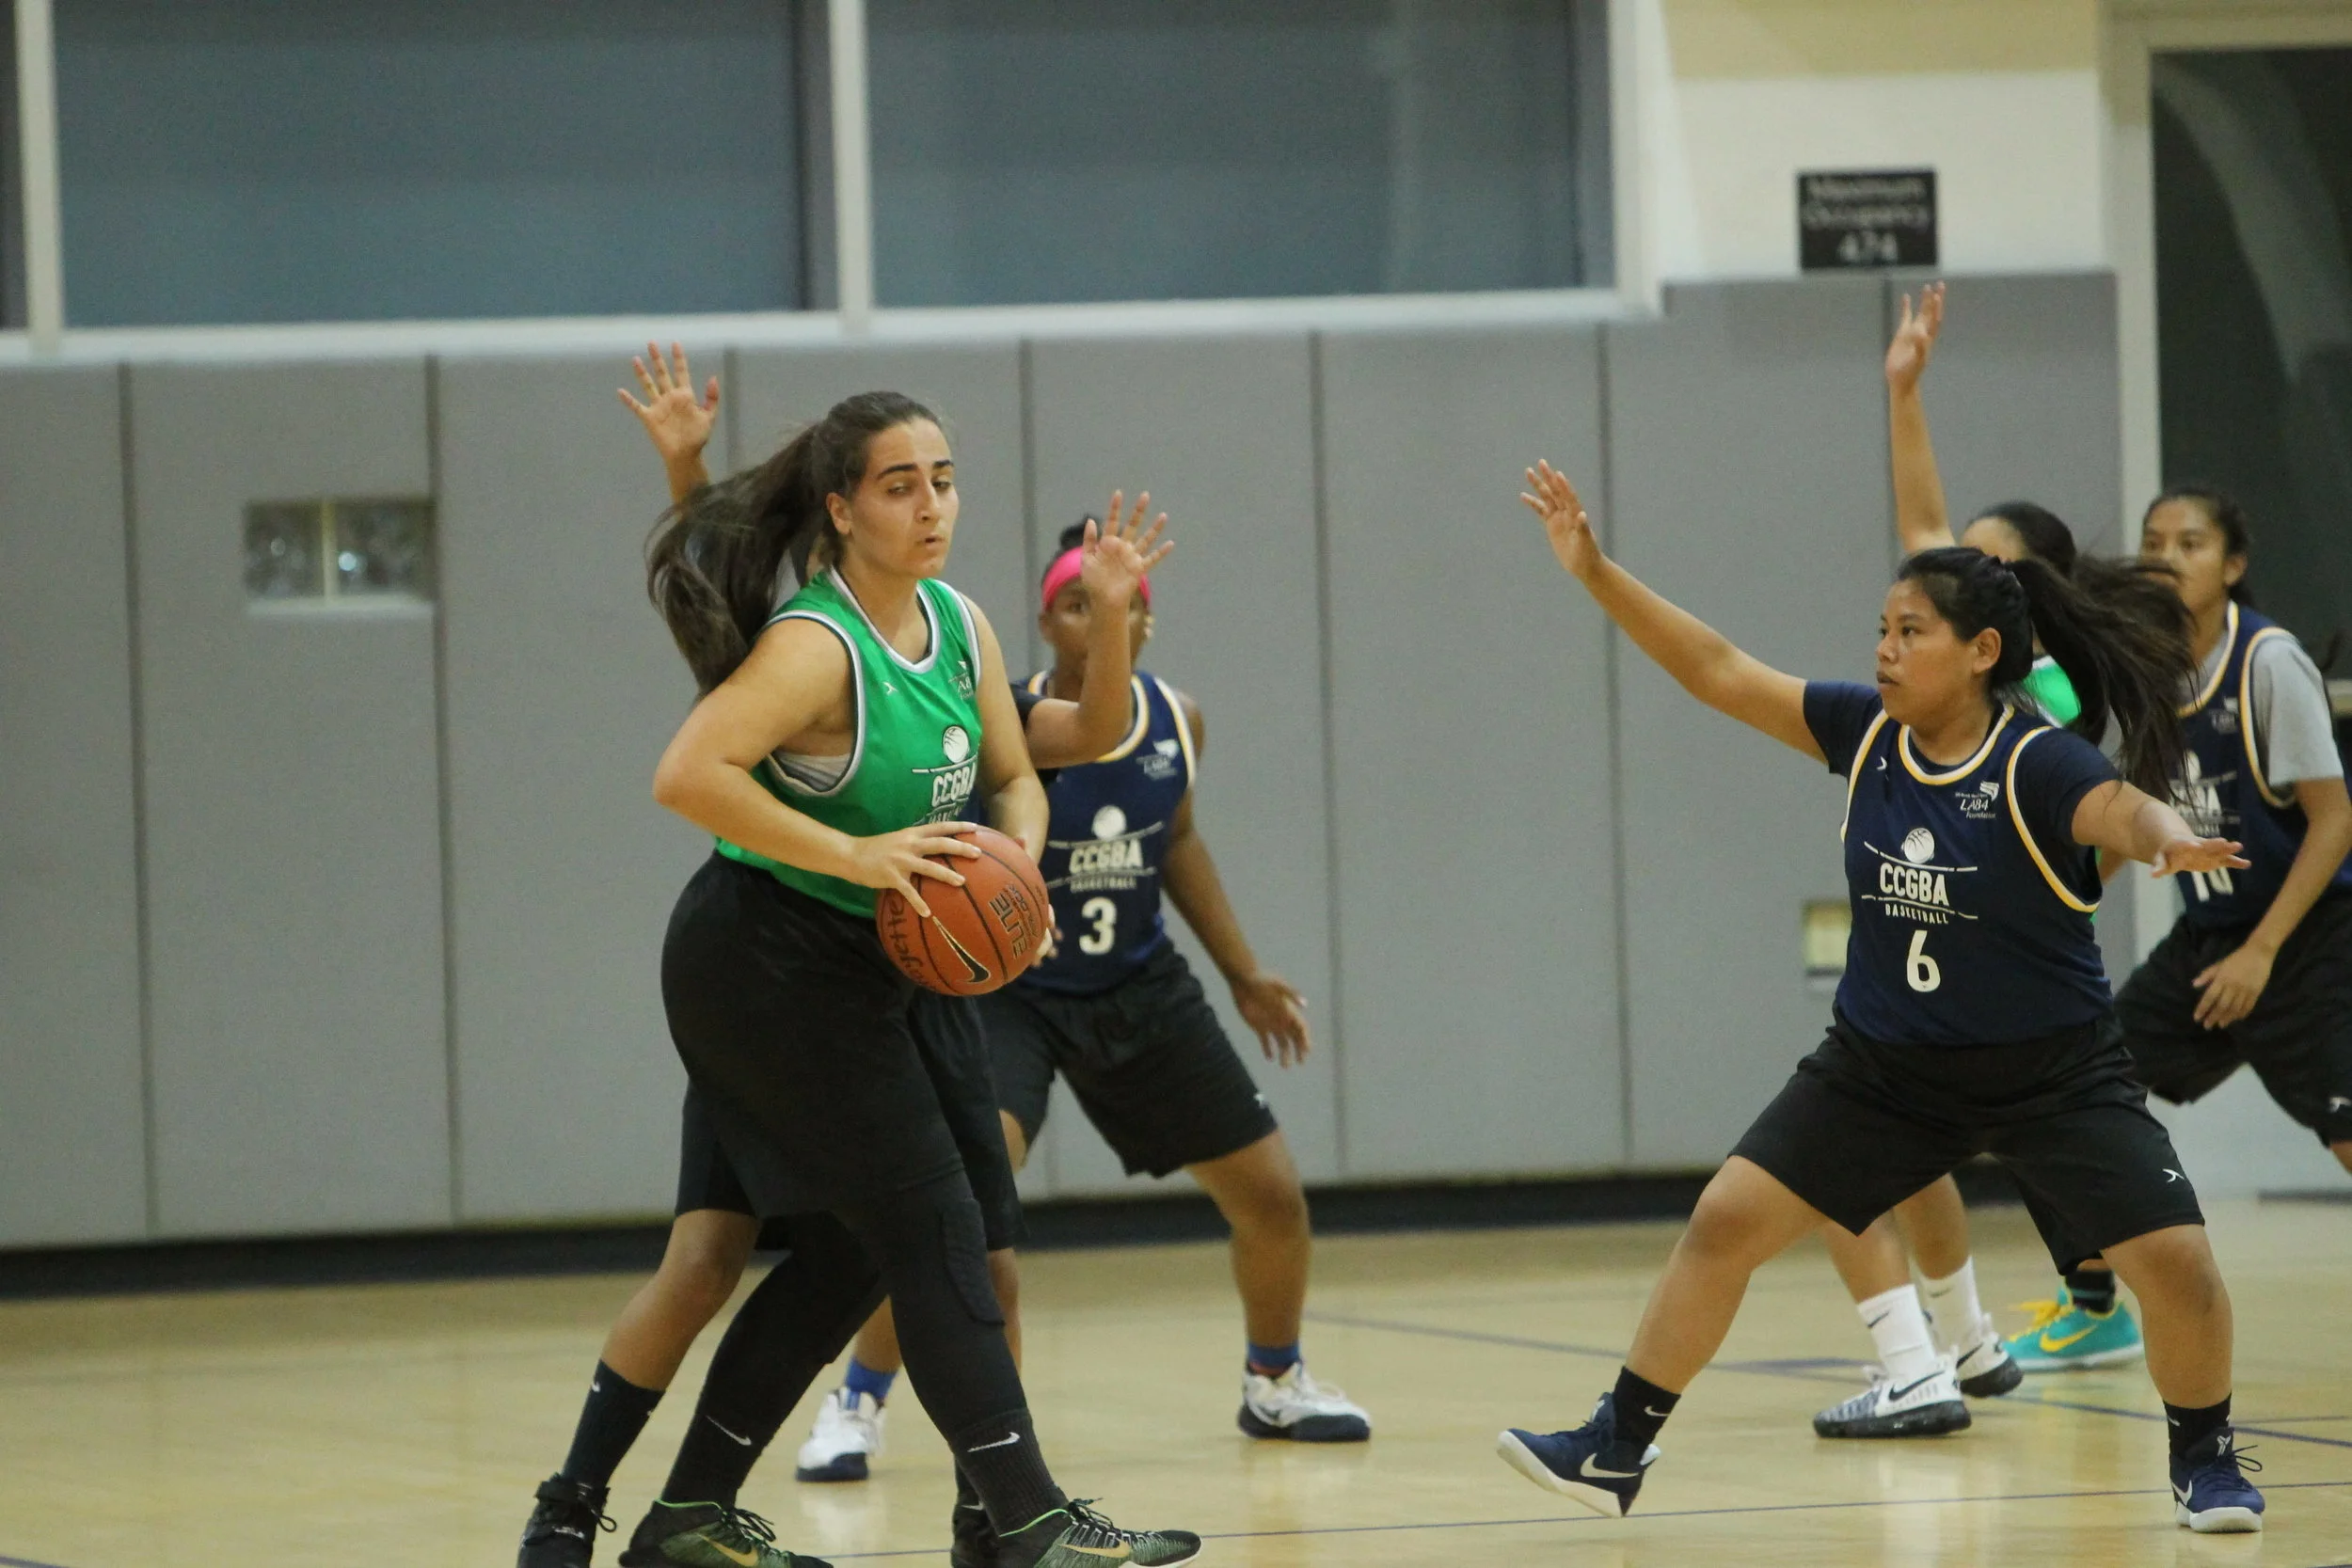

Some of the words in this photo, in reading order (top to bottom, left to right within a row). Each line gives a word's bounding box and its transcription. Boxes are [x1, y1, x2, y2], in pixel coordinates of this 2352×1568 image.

[1068, 837, 1144, 875] CCGBA
[1880, 862, 1949, 907] CCGBA
[1079, 896, 1118, 956] 3
[1884, 903, 1949, 925] BASKETBALL
[1906, 929, 1941, 992] 6
